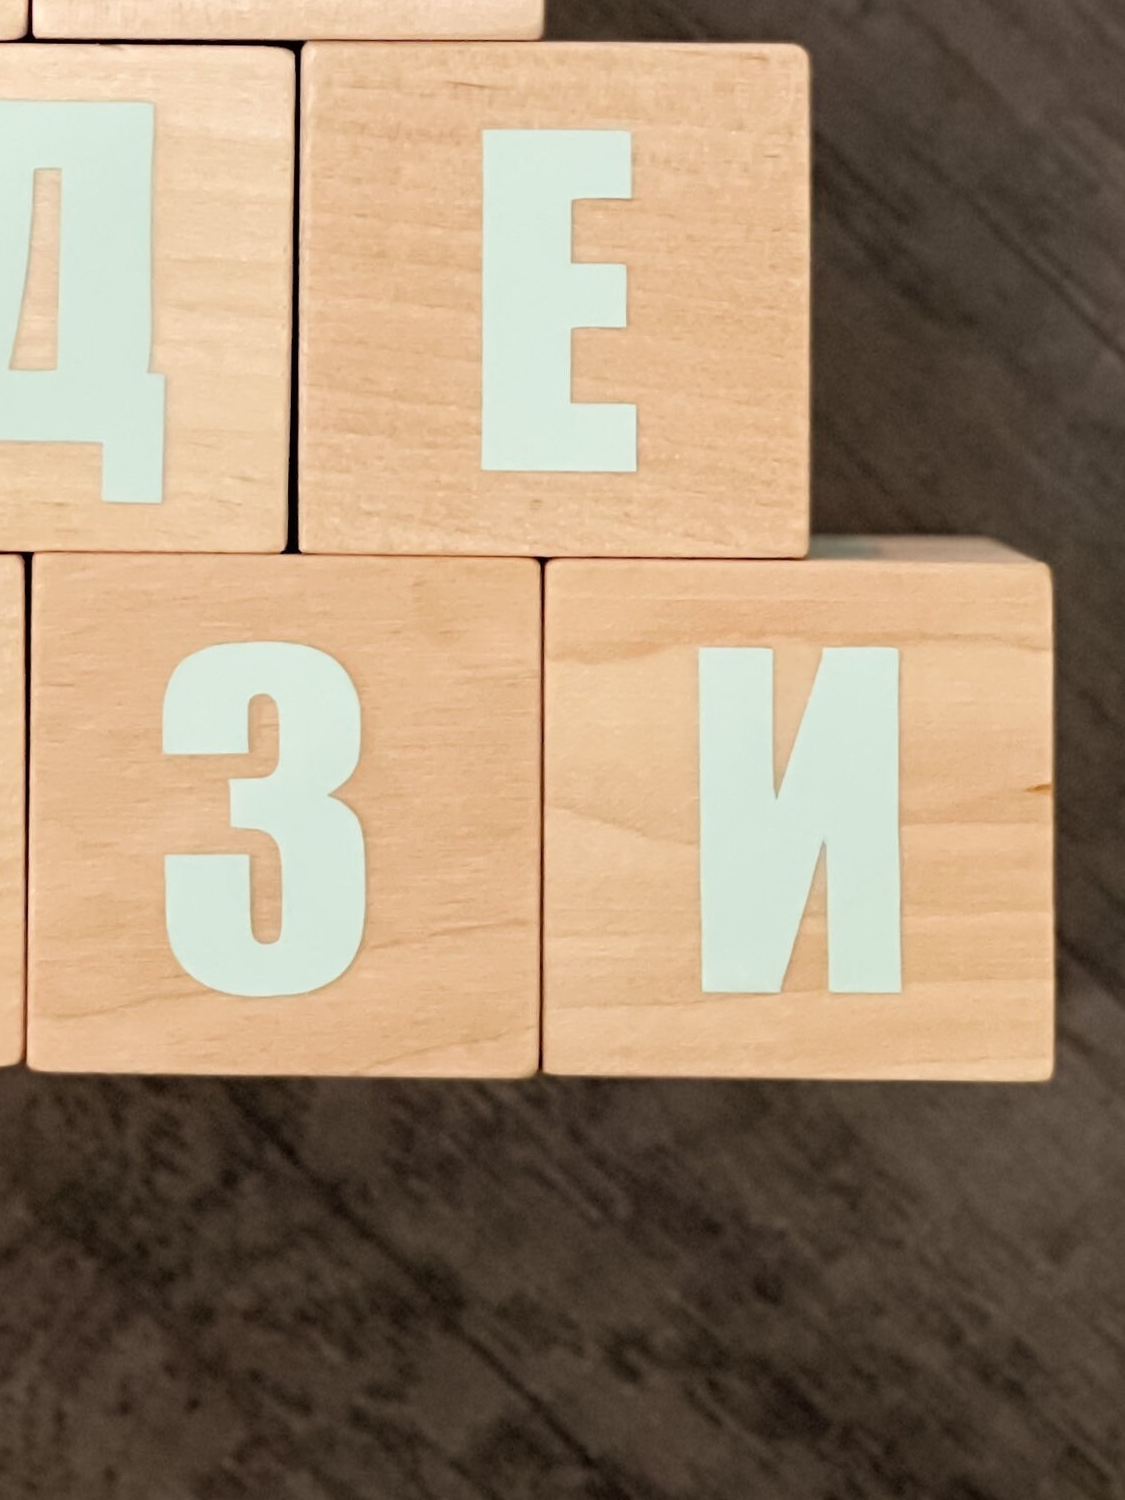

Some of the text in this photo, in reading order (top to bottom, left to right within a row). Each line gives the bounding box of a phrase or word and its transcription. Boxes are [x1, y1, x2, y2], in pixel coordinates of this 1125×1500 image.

[480, 129, 638, 473] Е
[162, 642, 366, 998] З
[697, 646, 902, 994] И
